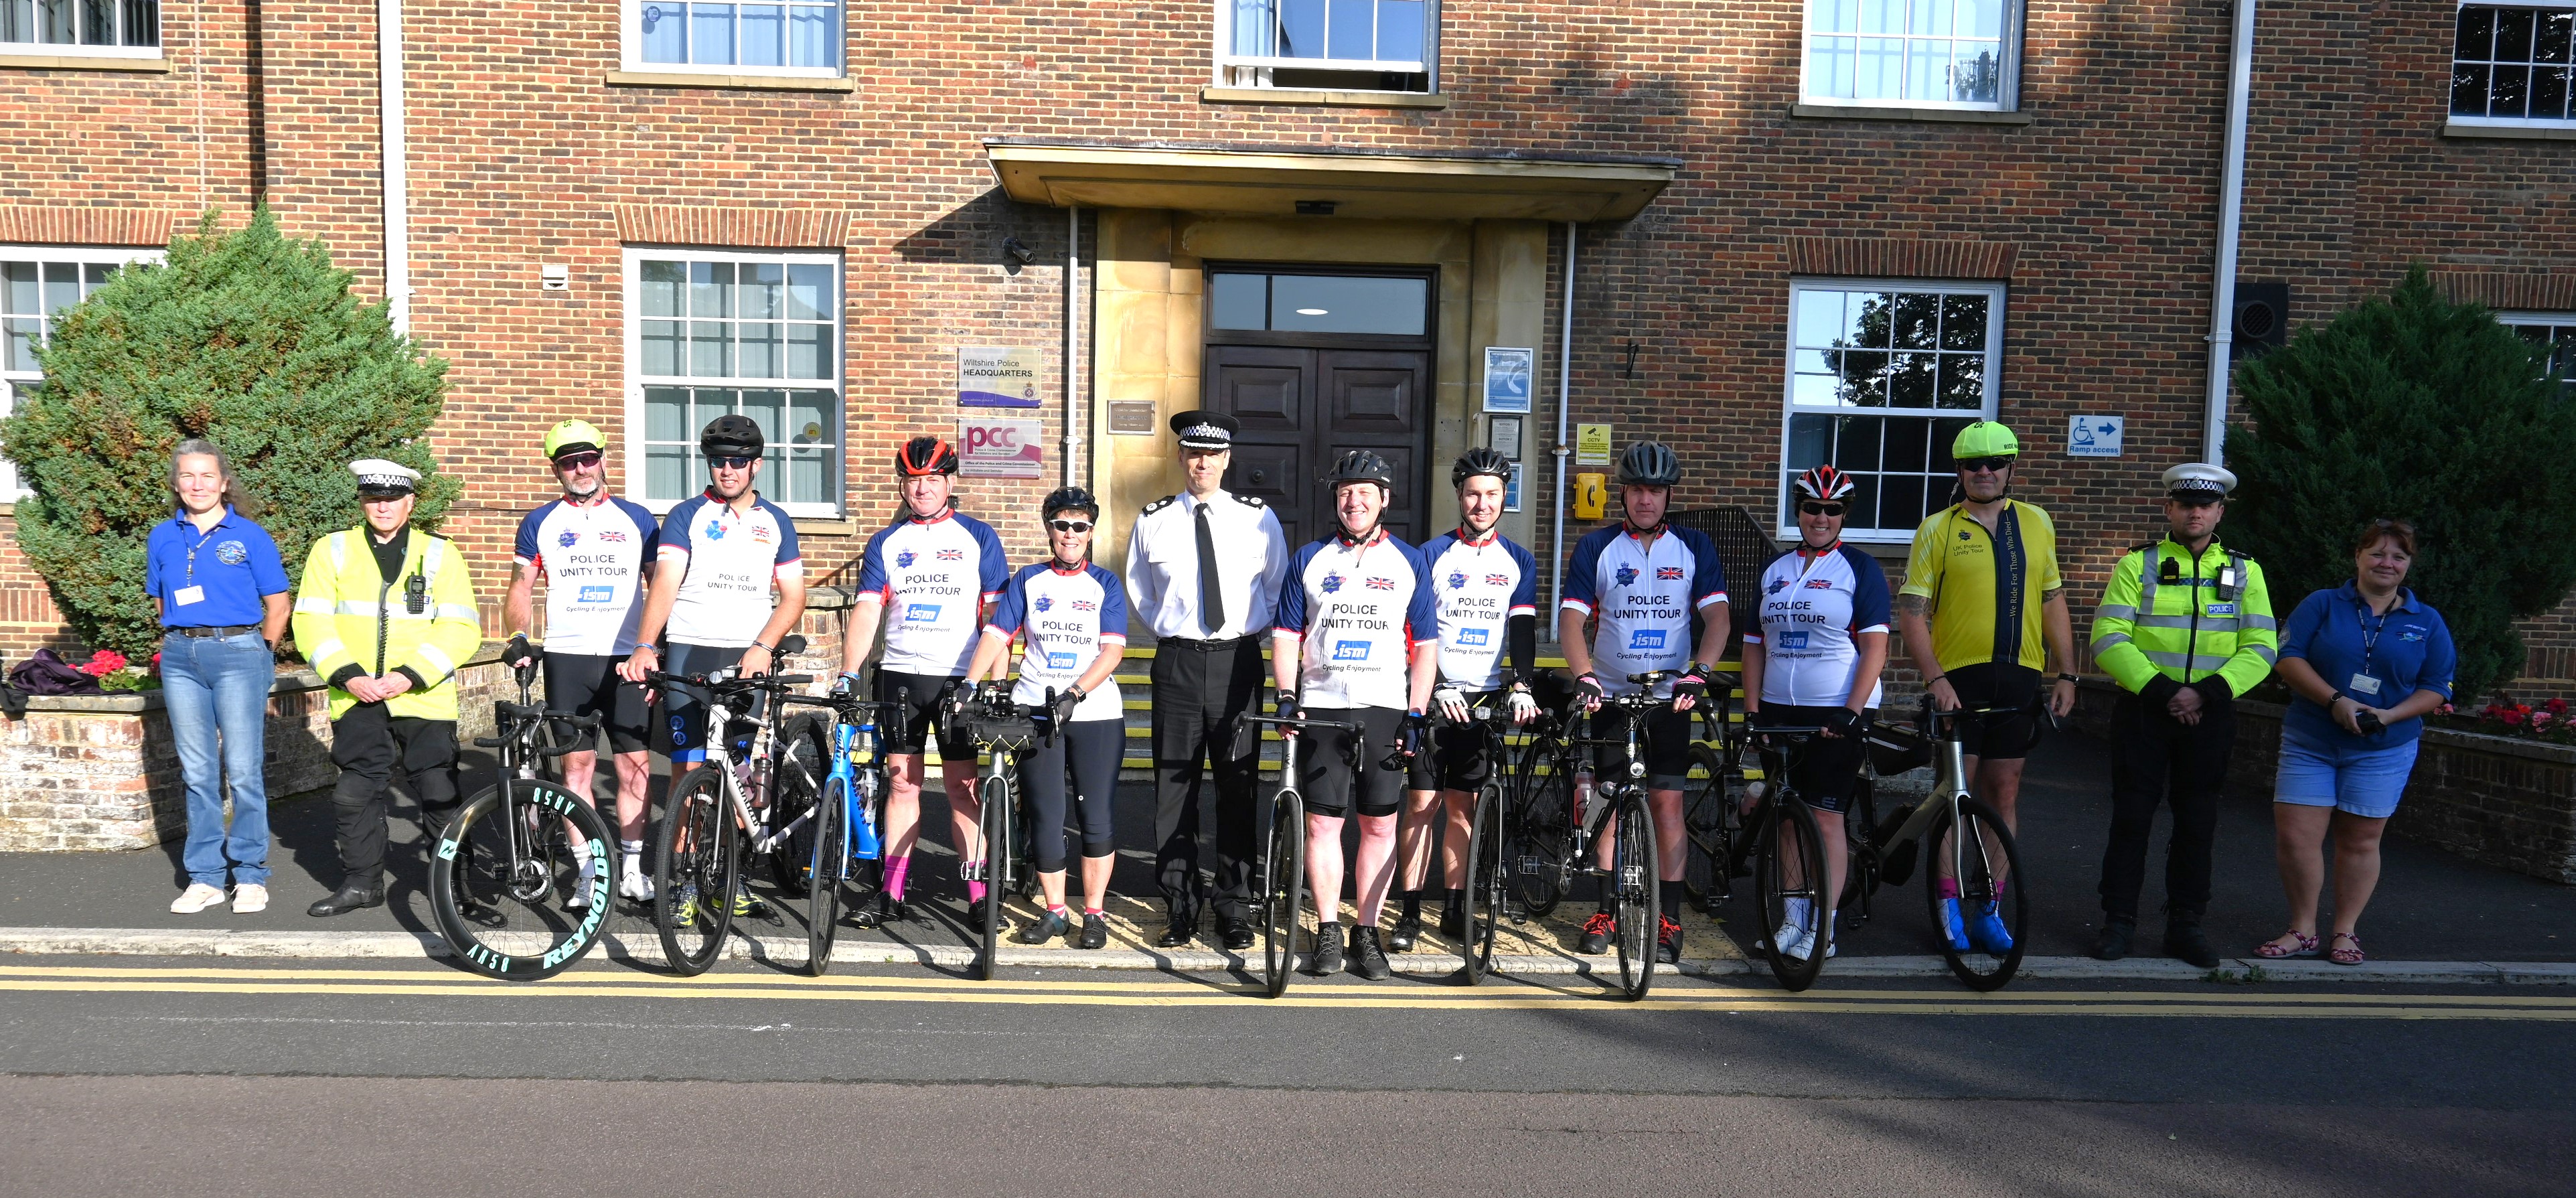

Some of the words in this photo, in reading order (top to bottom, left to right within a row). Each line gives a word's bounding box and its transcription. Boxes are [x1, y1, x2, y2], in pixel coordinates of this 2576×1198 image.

[963, 369, 1033, 377] HEADQUARTERS
[968, 427, 1016, 454] pcc
[2004, 521, 2012, 535] Died
[2006, 534, 2014, 550] Who
[571, 554, 615, 563] POLICE
[2010, 550, 2018, 572] Those
[560, 567, 593, 577] UNITY
[597, 567, 627, 576] TOUR
[719, 573, 750, 581] POLICE
[905, 574, 950, 584] POLICE
[930, 587, 961, 595] TOUR
[2010, 587, 2018, 603] Ride
[1458, 597, 1495, 607] POLICE
[1628, 595, 1670, 605] POLICE
[1332, 604, 1377, 615] POLICE
[1768, 601, 1811, 611] POLICE
[2010, 605, 2017, 617] We
[909, 607, 936, 619] ism
[1446, 609, 1475, 618] UNITY
[1478, 611, 1501, 619] TOUR
[1614, 609, 1648, 619] UNITY
[1651, 609, 1681, 619] TOUR
[1322, 618, 1353, 628] UNITY
[1356, 619, 1389, 629] TOUR
[1760, 615, 1787, 624] UNITY
[1791, 614, 1826, 624] TOUR
[1042, 621, 1083, 632] POLICE
[1033, 633, 1061, 642] UNITY
[1065, 635, 1092, 645] TOUR
[1462, 631, 1486, 644] ism
[1636, 633, 1662, 646] ism
[1783, 635, 1805, 646] ism
[1338, 644, 1367, 658] ism
[1643, 652, 1677, 660] Enjoyment
[1050, 655, 1074, 667] ism
[543, 838, 610, 969] REYNOLDS
